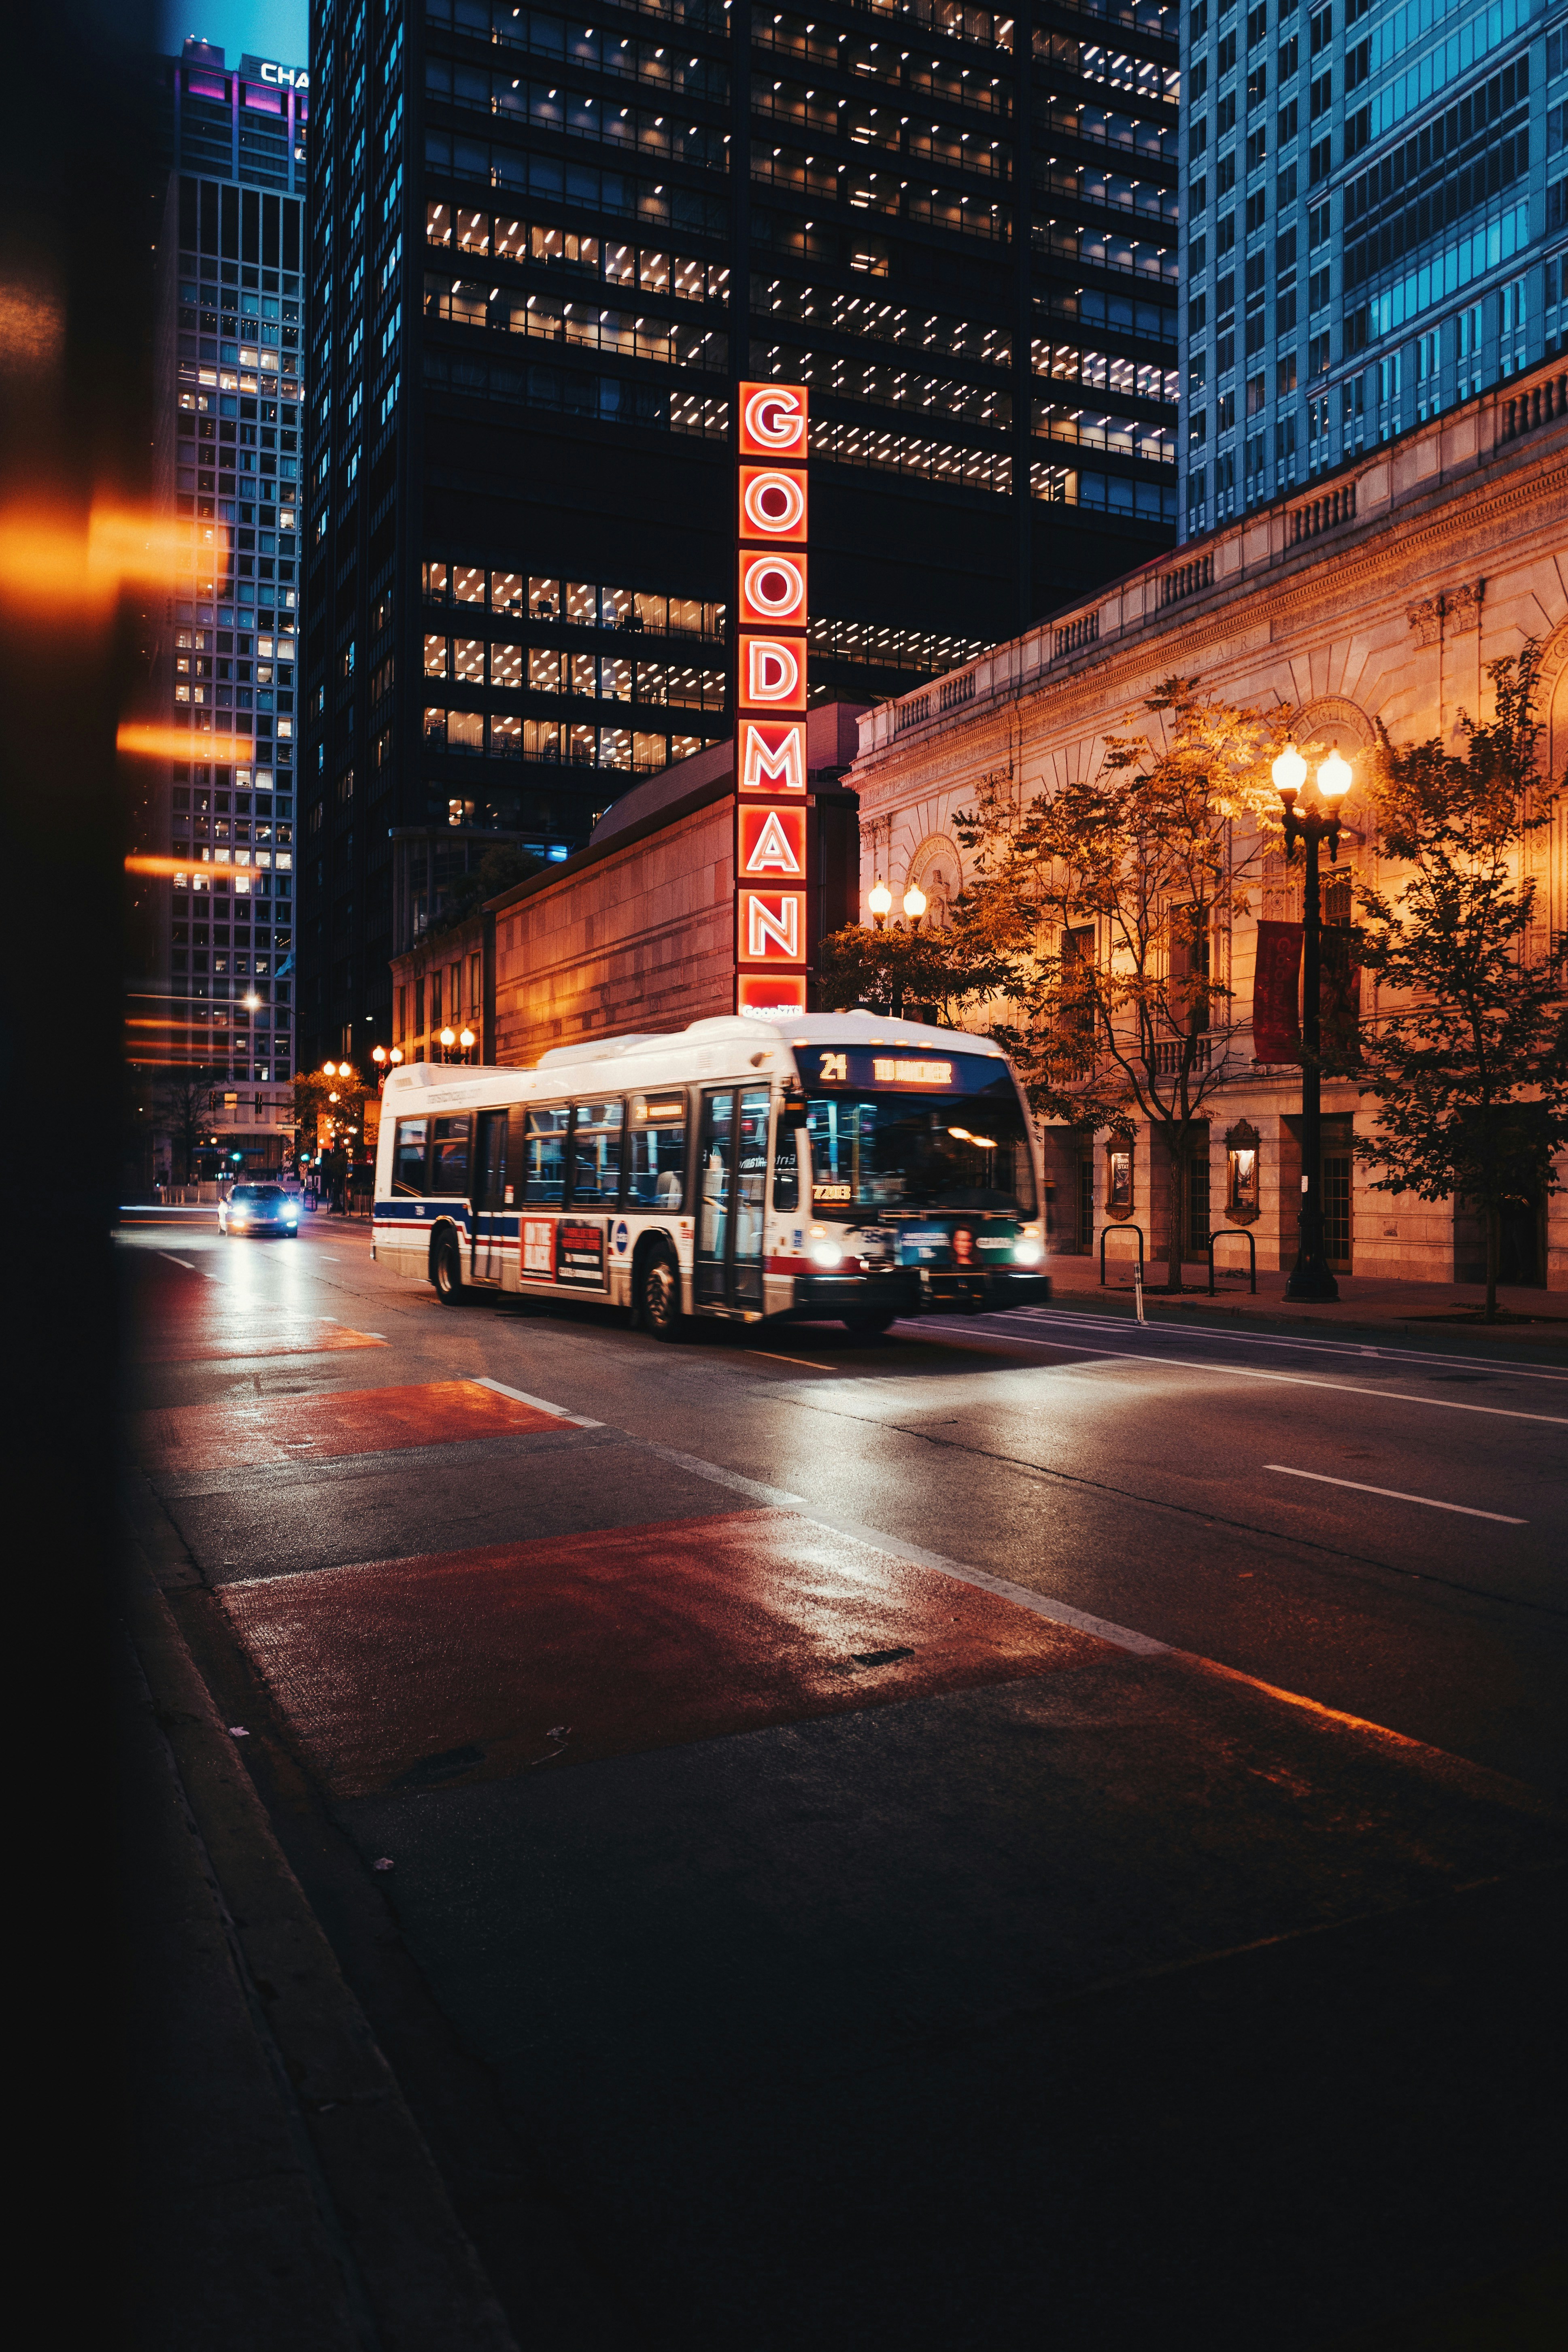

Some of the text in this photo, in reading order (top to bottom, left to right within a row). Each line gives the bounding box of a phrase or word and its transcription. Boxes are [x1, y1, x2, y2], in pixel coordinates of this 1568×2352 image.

[744, 389, 803, 956] GOODMAN
[1114, 630, 1260, 703] HARRIS THEATRE
